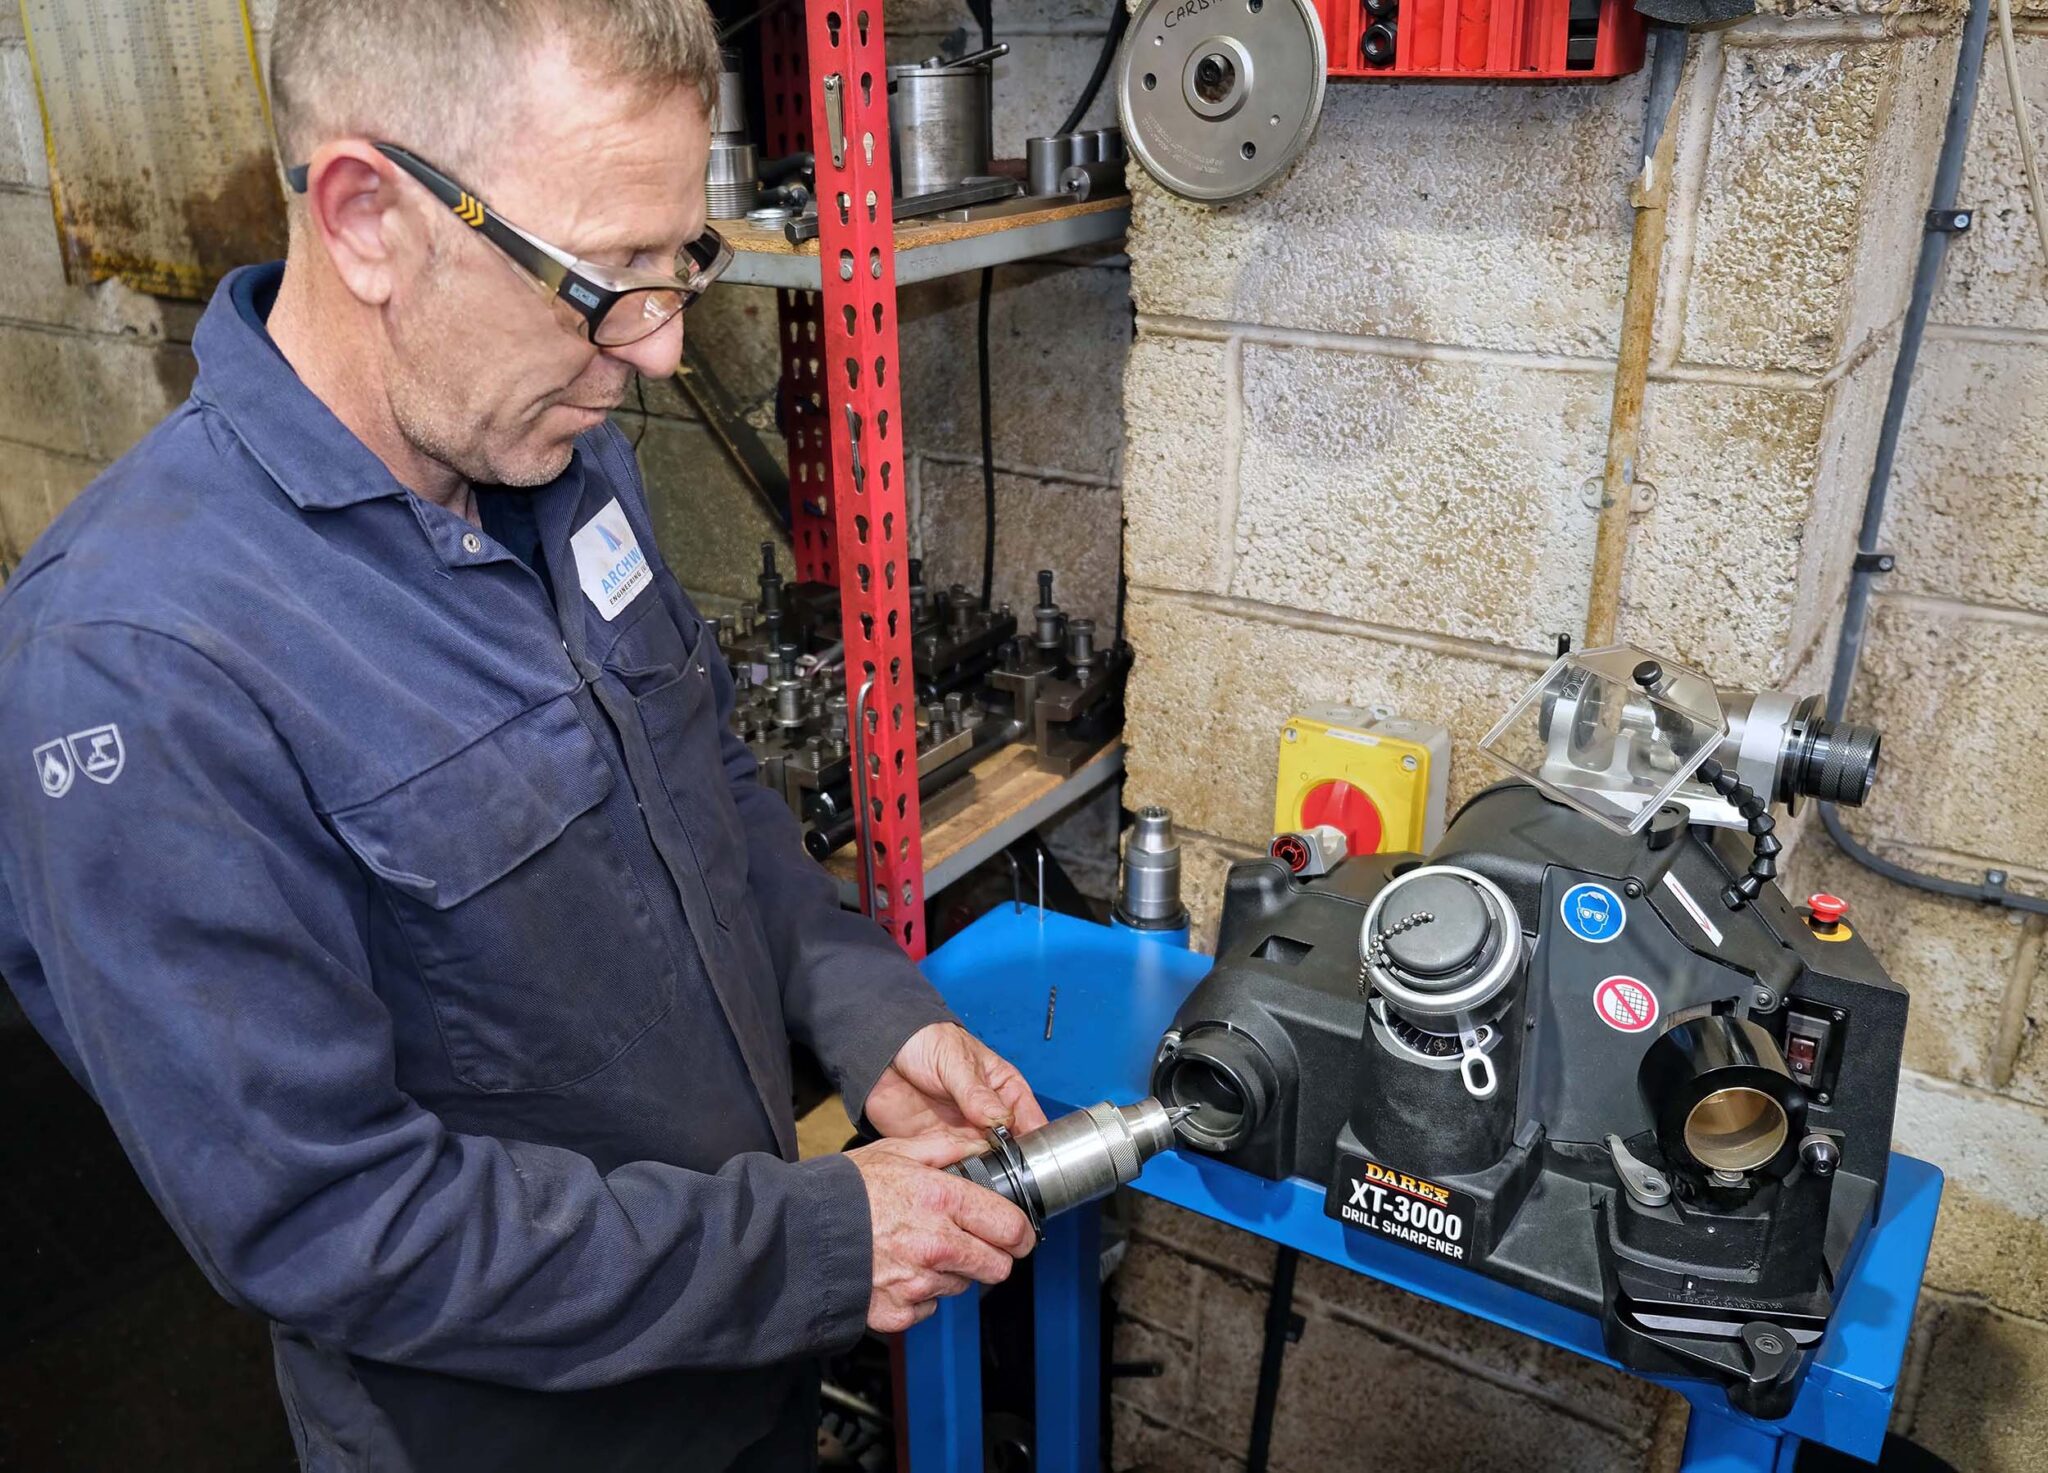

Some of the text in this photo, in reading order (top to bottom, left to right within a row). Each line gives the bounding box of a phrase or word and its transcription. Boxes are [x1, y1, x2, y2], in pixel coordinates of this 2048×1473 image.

[1165, 0, 1223, 28] CARB
[609, 569, 642, 606] ENGINEERING
[1365, 1162, 1451, 1205] DAREX
[1348, 1177, 1462, 1242] XT-3000
[1341, 1205, 1464, 1260] DRILL SHARPENER
[1702, 1298, 1717, 1306] 130
